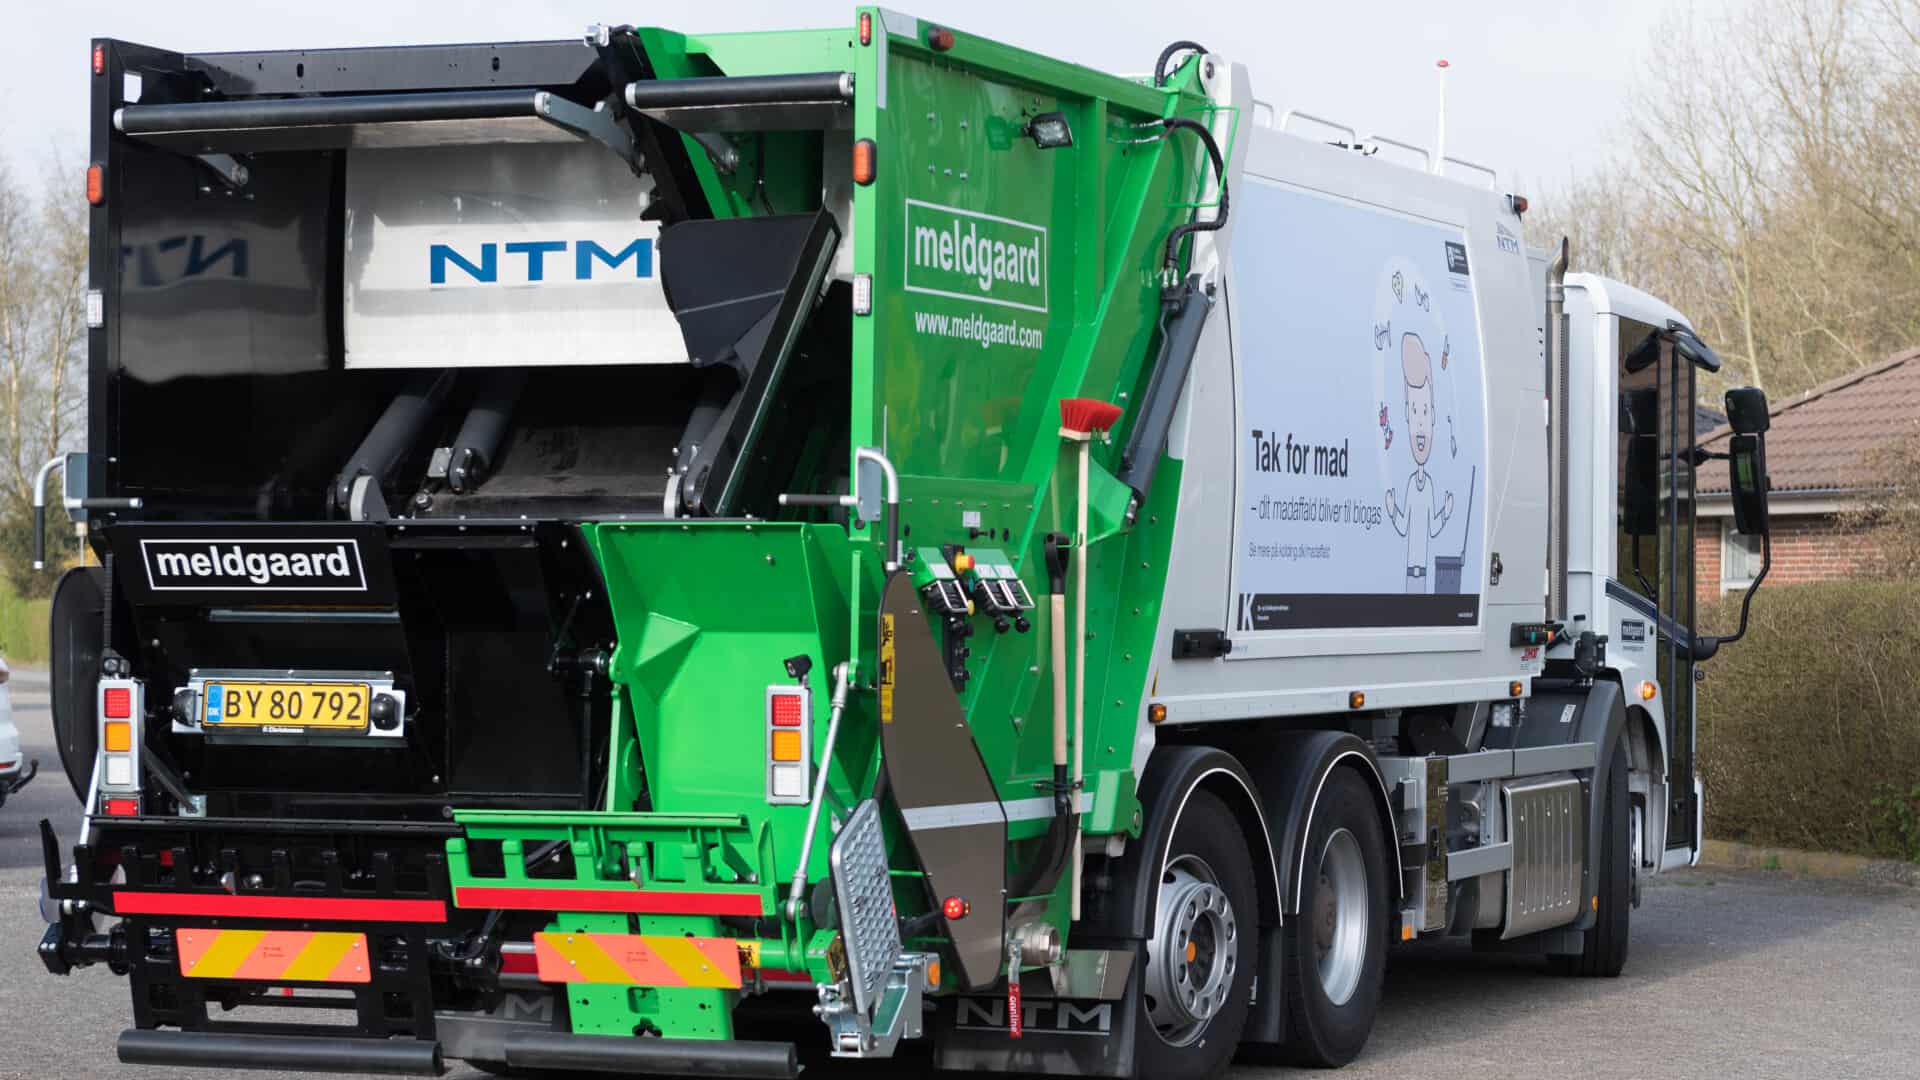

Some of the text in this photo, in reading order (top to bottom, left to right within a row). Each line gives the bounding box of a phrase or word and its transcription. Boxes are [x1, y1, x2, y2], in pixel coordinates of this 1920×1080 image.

[430, 238, 653, 284] NTM
[914, 219, 1040, 292] meldgaard
[914, 311, 1043, 350] www.meldgaard.com
[1251, 430, 1349, 477] Tak for mad
[1258, 495, 1271, 520] dit
[1272, 496, 1317, 522] madaffald
[1318, 497, 1343, 523] bliver
[1344, 499, 1352, 524] til
[1352, 500, 1382, 530] biogas
[157, 545, 351, 584] meldgaard
[1241, 592, 1256, 631] K
[225, 689, 363, 721] BY 80 792
[956, 998, 1112, 1031] NTM
